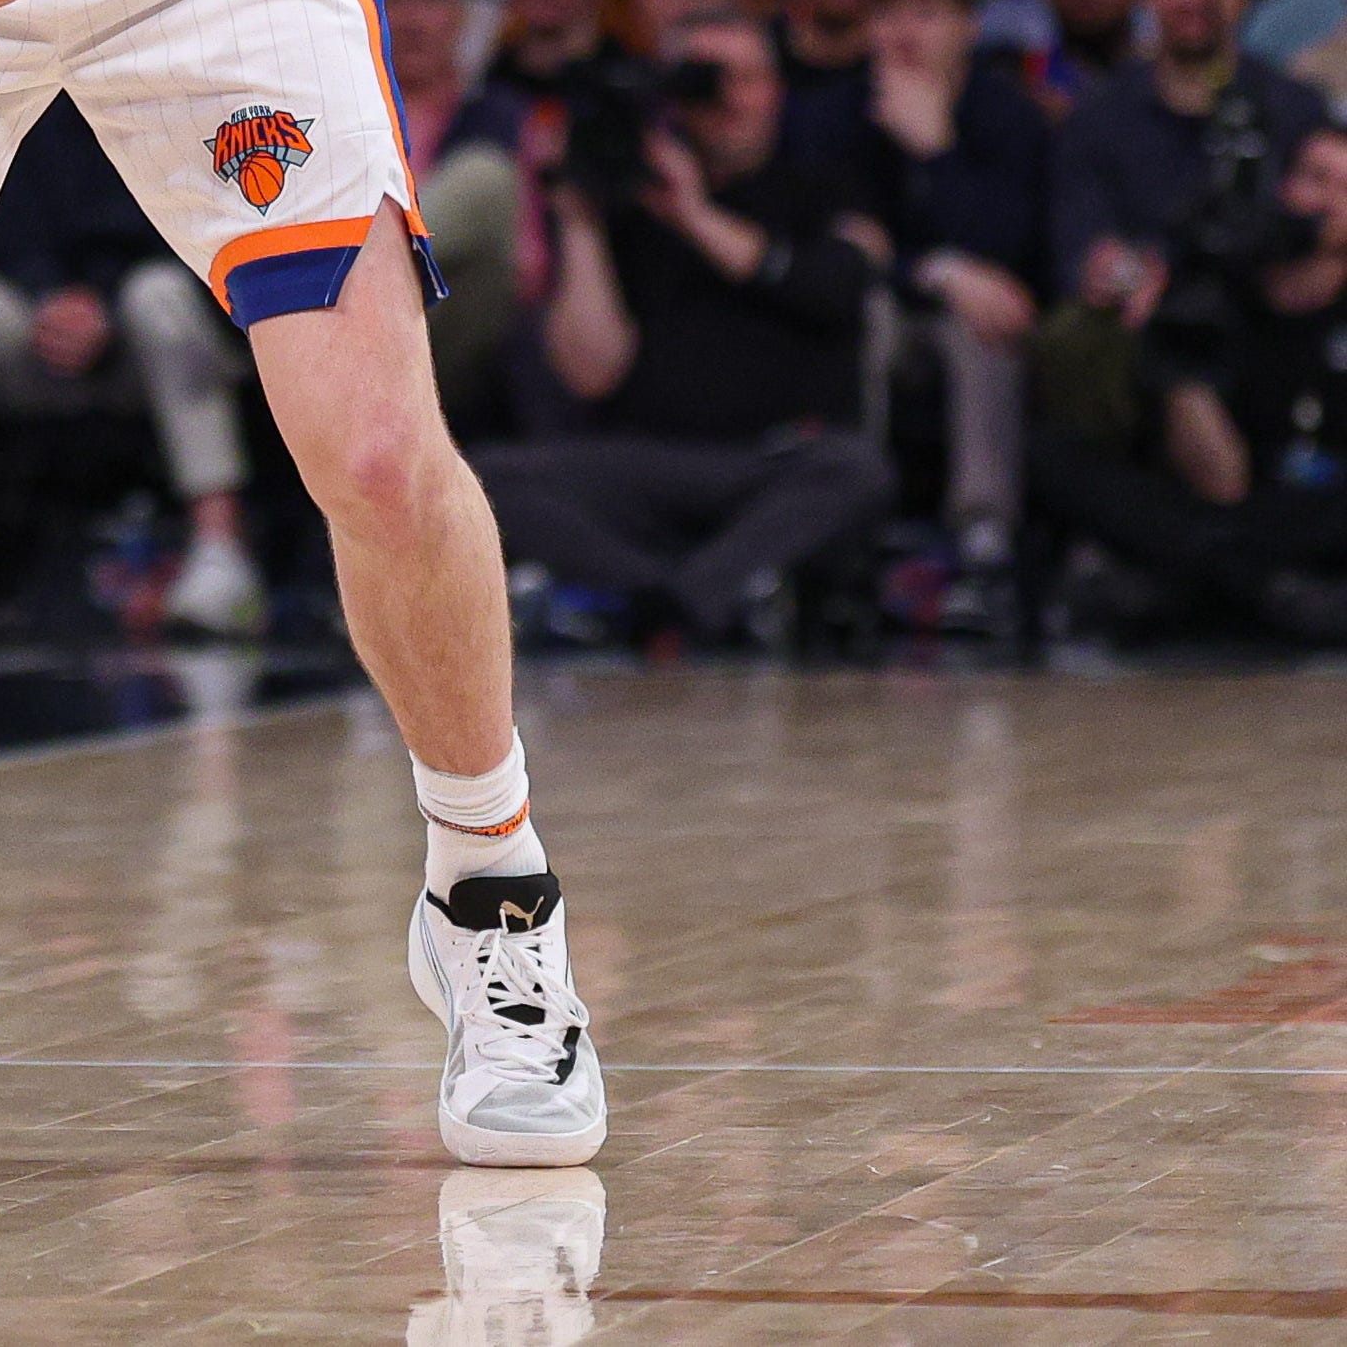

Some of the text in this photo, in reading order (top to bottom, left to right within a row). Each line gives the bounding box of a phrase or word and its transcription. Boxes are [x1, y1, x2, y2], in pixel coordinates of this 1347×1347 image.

[230, 104, 273, 124] NEW YORK
[214, 110, 313, 172] KNICKS
